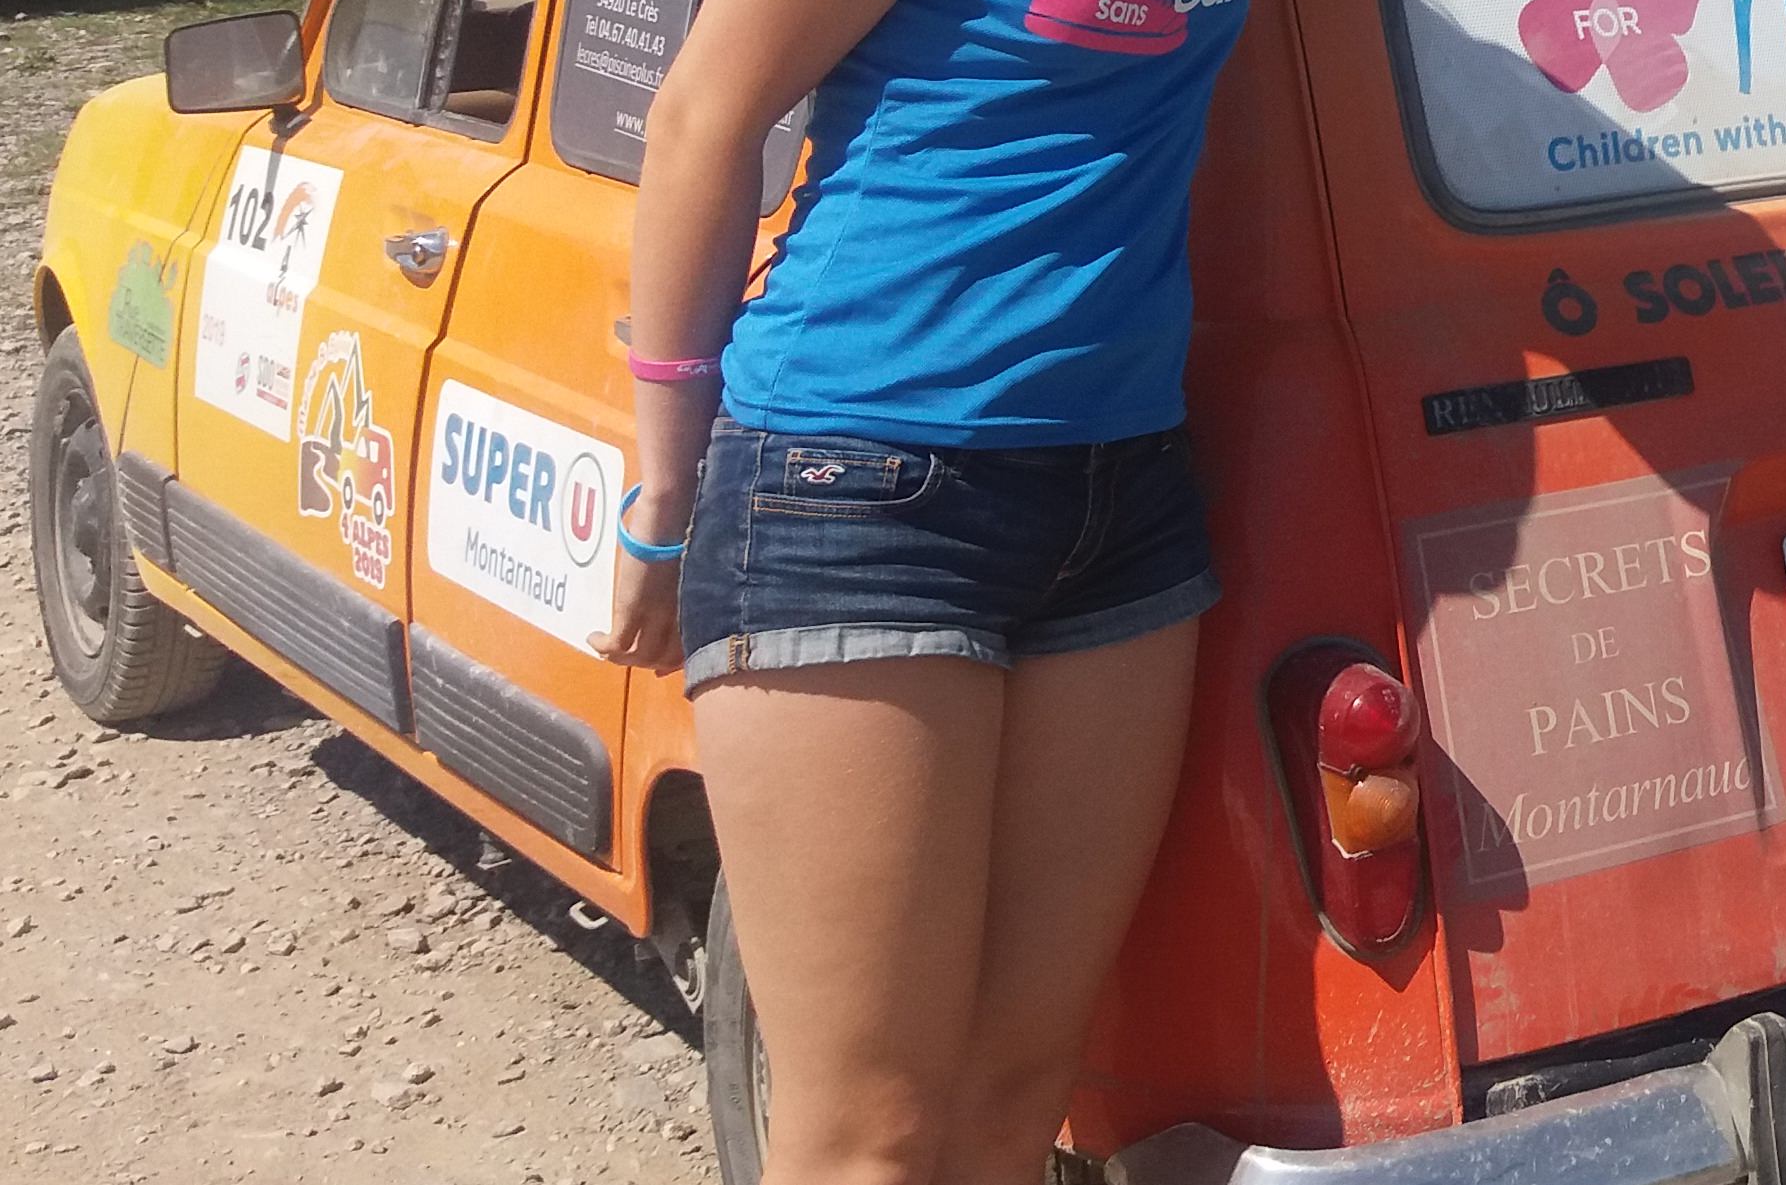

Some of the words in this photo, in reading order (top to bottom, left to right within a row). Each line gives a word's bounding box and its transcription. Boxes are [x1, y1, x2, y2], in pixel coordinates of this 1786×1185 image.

[584, 14, 598, 36] Tel
[598, 18, 666, 57] 04.67.40.41.43
[638, 0, 660, 23] Crès
[1572, 5, 1641, 40] FOR
[1547, 126, 1704, 174] Children
[227, 184, 274, 251] 102
[1541, 267, 1599, 337] Ô
[441, 413, 557, 532] SUPER
[571, 481, 596, 542] U
[465, 526, 568, 612] Montarnaud
[1469, 529, 1712, 621] SECRETS
[1571, 626, 1620, 665] DE
[1525, 676, 1691, 756] PAINS
